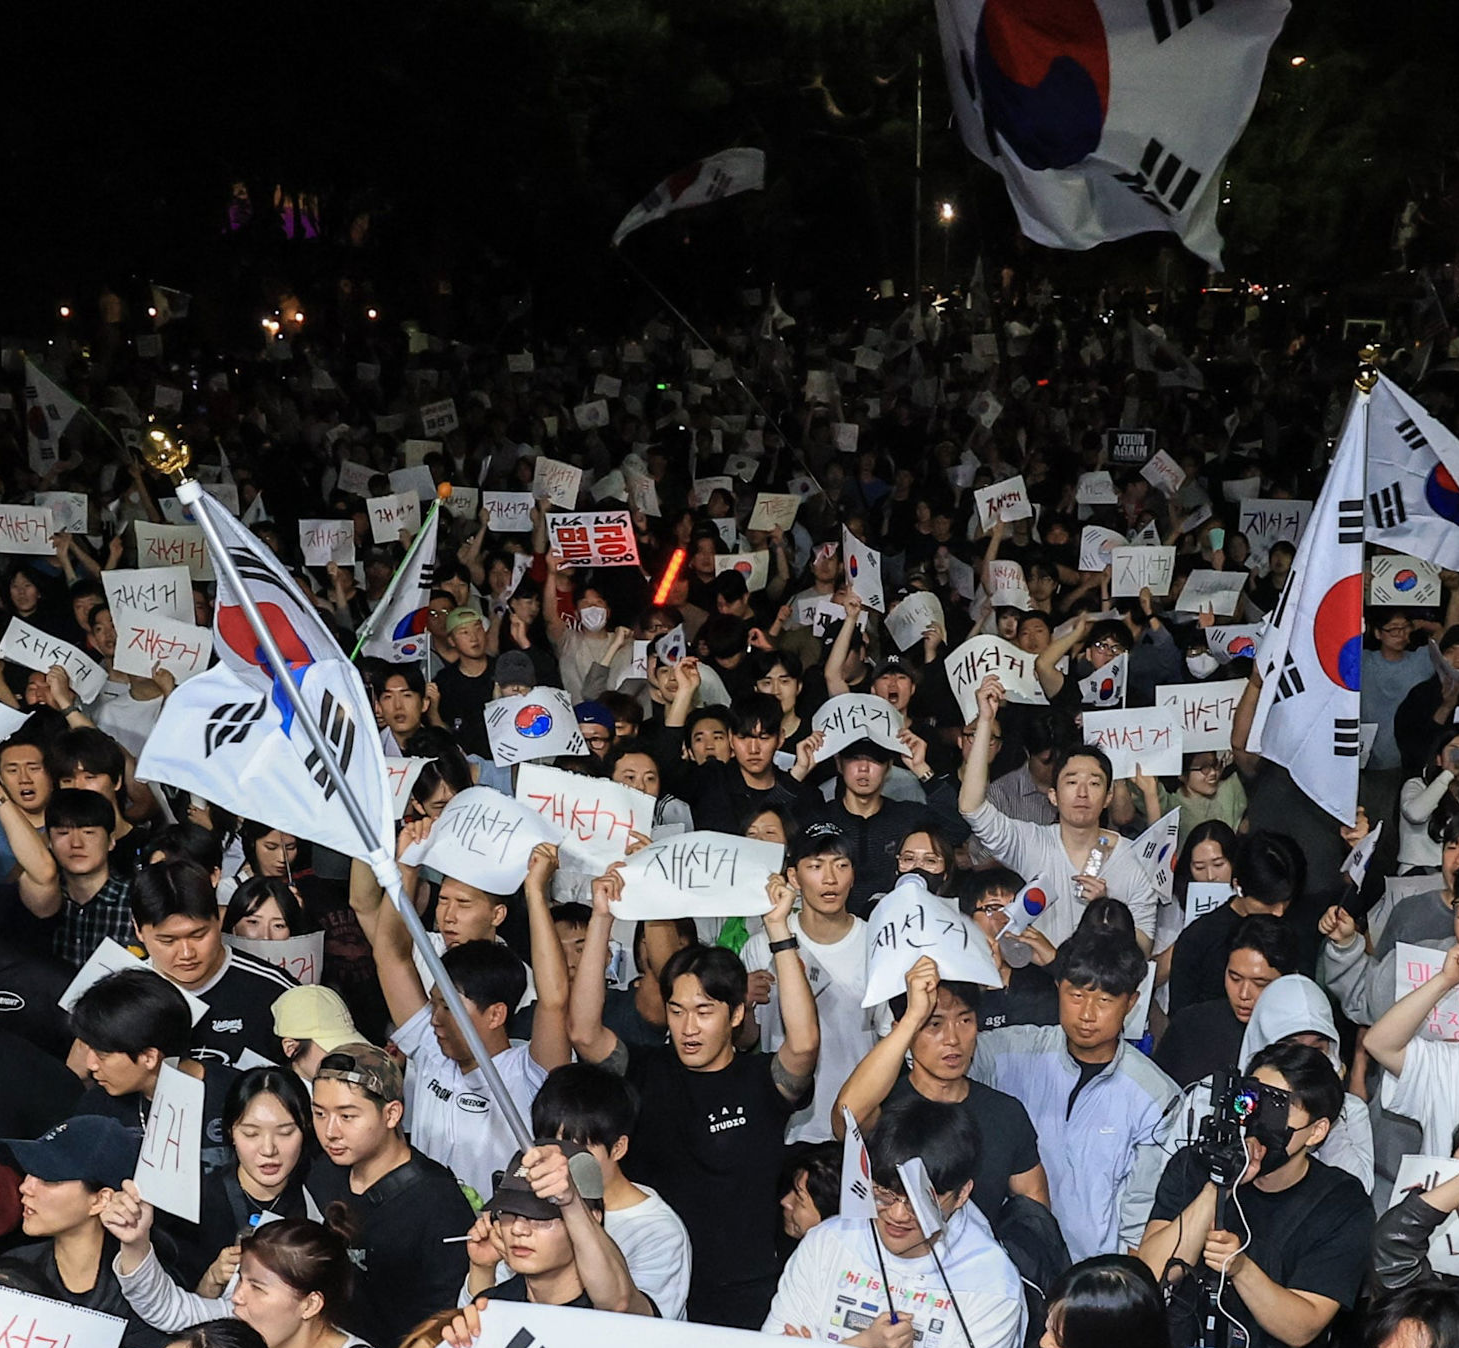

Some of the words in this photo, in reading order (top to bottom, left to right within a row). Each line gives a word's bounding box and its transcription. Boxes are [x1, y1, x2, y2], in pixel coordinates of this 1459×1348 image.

[1113, 445, 1148, 458] AGAIN
[486, 501, 529, 520] 재선거
[145, 536, 206, 570] 재선거
[305, 528, 354, 553] 재선거
[111, 581, 178, 613] 재선거
[15, 628, 93, 682] 재선거
[128, 626, 202, 671] 재선거
[952, 645, 1024, 695] 재선거
[821, 703, 891, 737] 재선거
[1090, 726, 1173, 752] 재선거
[446, 804, 524, 863] 재선거
[527, 790, 639, 856] 재선거
[647, 840, 740, 891] 재선거
[870, 904, 970, 958] 재선거
[708, 1116, 747, 1134] STUDIO
